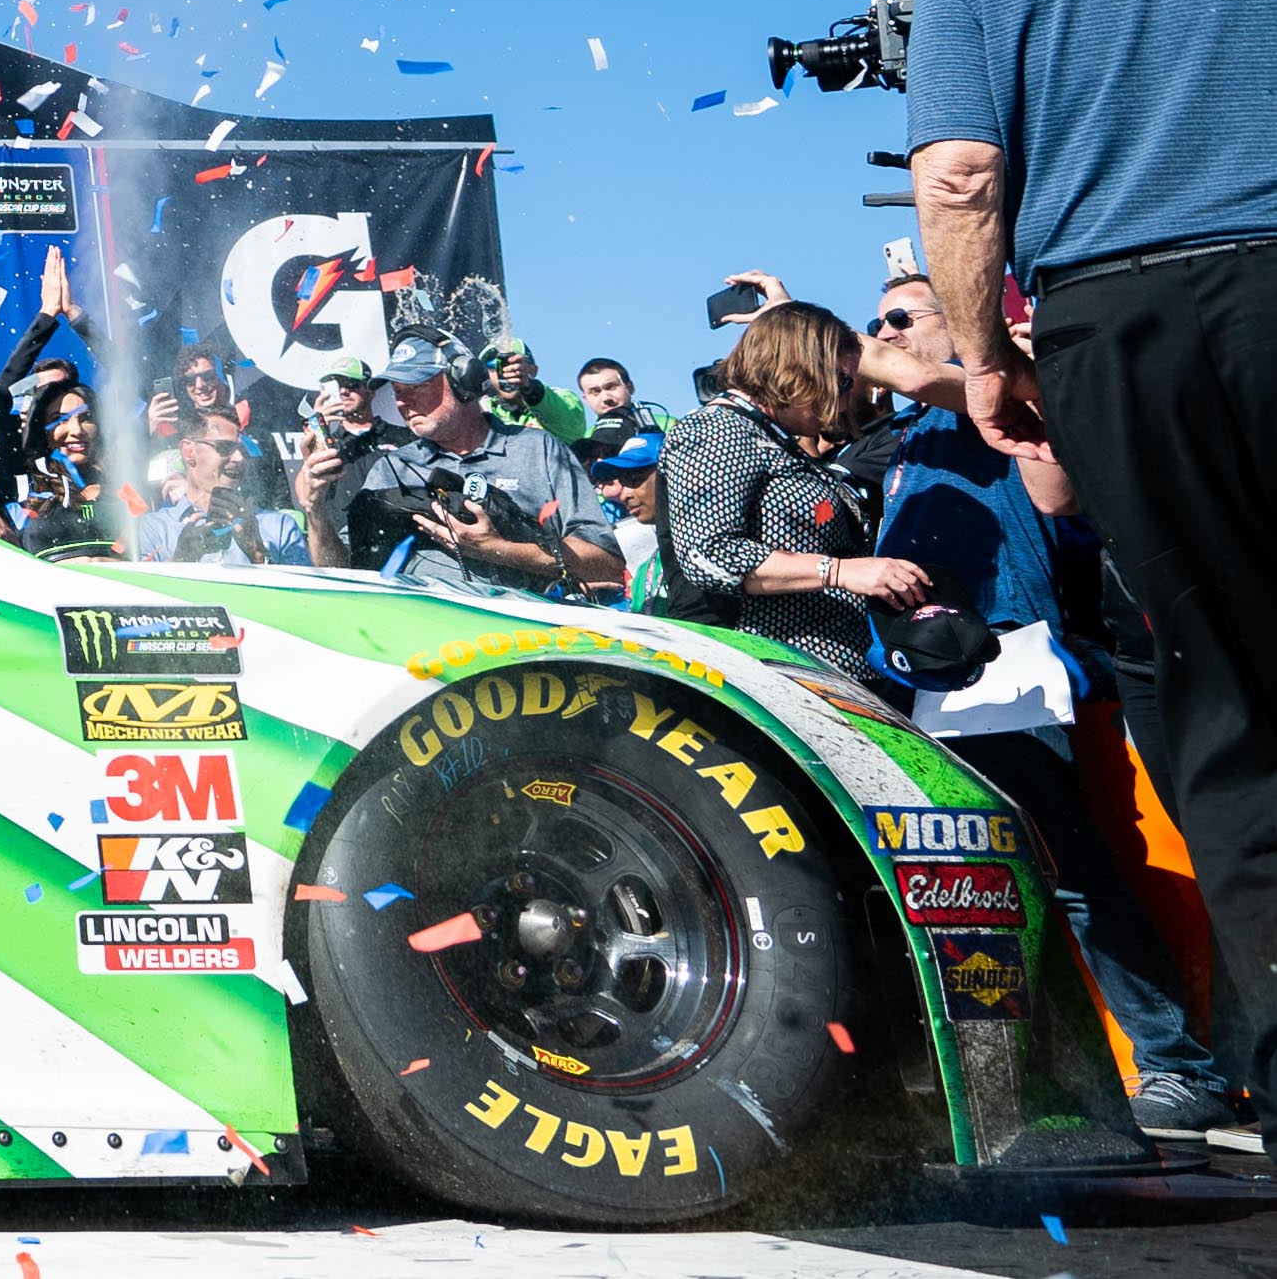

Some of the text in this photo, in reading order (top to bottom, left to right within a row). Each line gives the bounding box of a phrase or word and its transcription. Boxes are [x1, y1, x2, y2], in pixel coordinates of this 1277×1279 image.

[24, 204, 39, 212] CUP
[40, 204, 66, 212] SERIES
[119, 614, 225, 629] MONSTER
[140, 641, 175, 652] NASCAR
[176, 641, 195, 652] CUP
[86, 721, 243, 740] MECHANIX WEAR
[105, 754, 237, 822] 3M
[531, 784, 565, 797] AERO
[876, 812, 1016, 852] MOOG
[905, 874, 1019, 911] Edelbrock
[86, 916, 224, 942] LINCOLN
[118, 947, 240, 969] WELDERS
[948, 967, 1023, 990] SUNOCO
[541, 1055, 578, 1070] AERO
[463, 1080, 698, 1176] EAGLE
